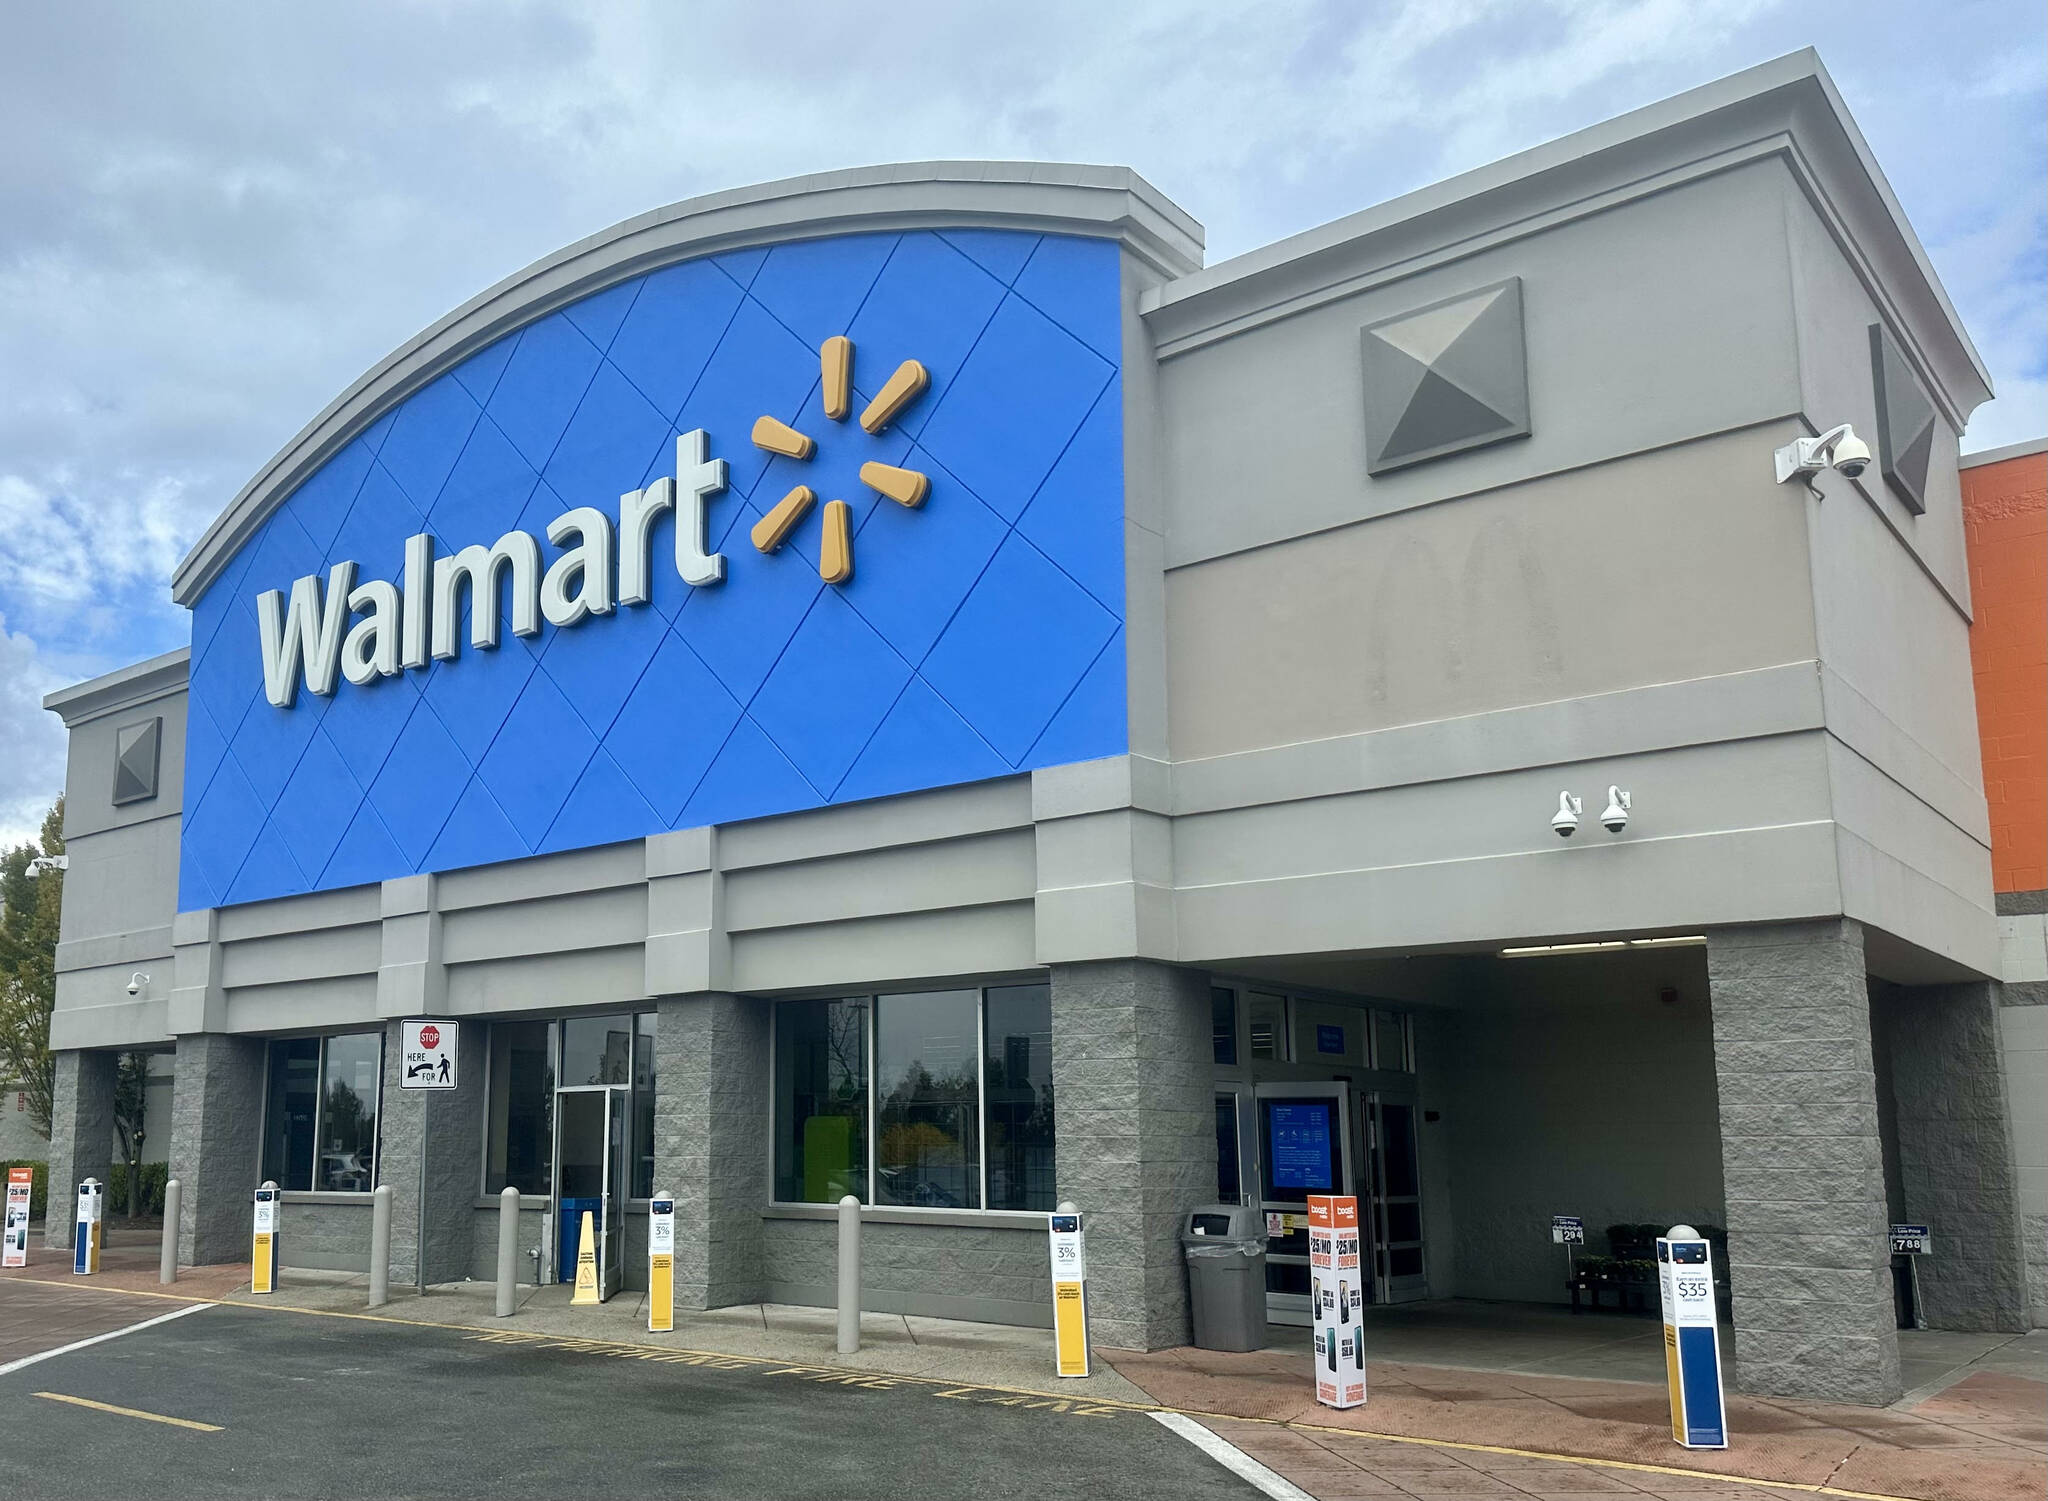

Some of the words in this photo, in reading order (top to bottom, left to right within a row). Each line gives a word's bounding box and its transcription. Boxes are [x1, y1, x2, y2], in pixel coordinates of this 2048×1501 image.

[256, 428, 729, 709] Walmart
[420, 1032, 439, 1042] STOP
[407, 1052, 426, 1062] HERE
[422, 1072, 436, 1082] FOR
[1311, 1205, 1328, 1215] boost
[1337, 1206, 1354, 1215] boost
[655, 1225, 670, 1236] 3%
[1057, 1246, 1076, 1259] 3%
[1678, 1281, 1707, 1298] $35
[763, 1367, 926, 1391] FIRE
[934, 1388, 1147, 1419] LANE
